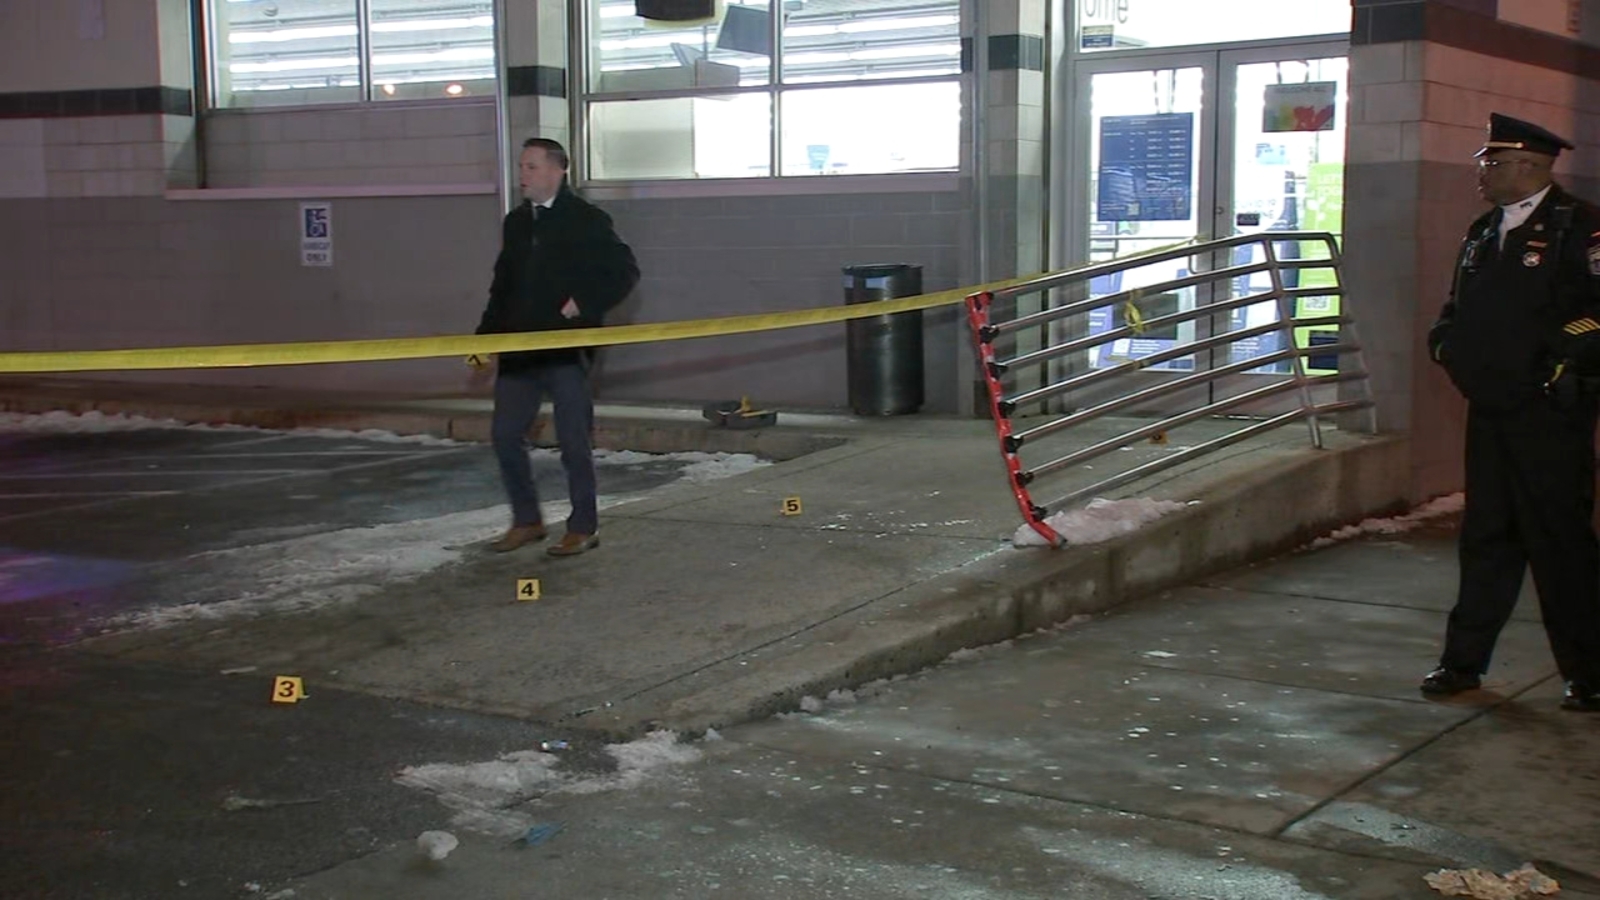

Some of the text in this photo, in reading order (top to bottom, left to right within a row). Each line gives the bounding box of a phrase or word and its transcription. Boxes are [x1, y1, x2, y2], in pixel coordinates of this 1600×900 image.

[786, 499, 799, 512] 5
[521, 582, 535, 597] 4
[278, 680, 295, 697] 3
